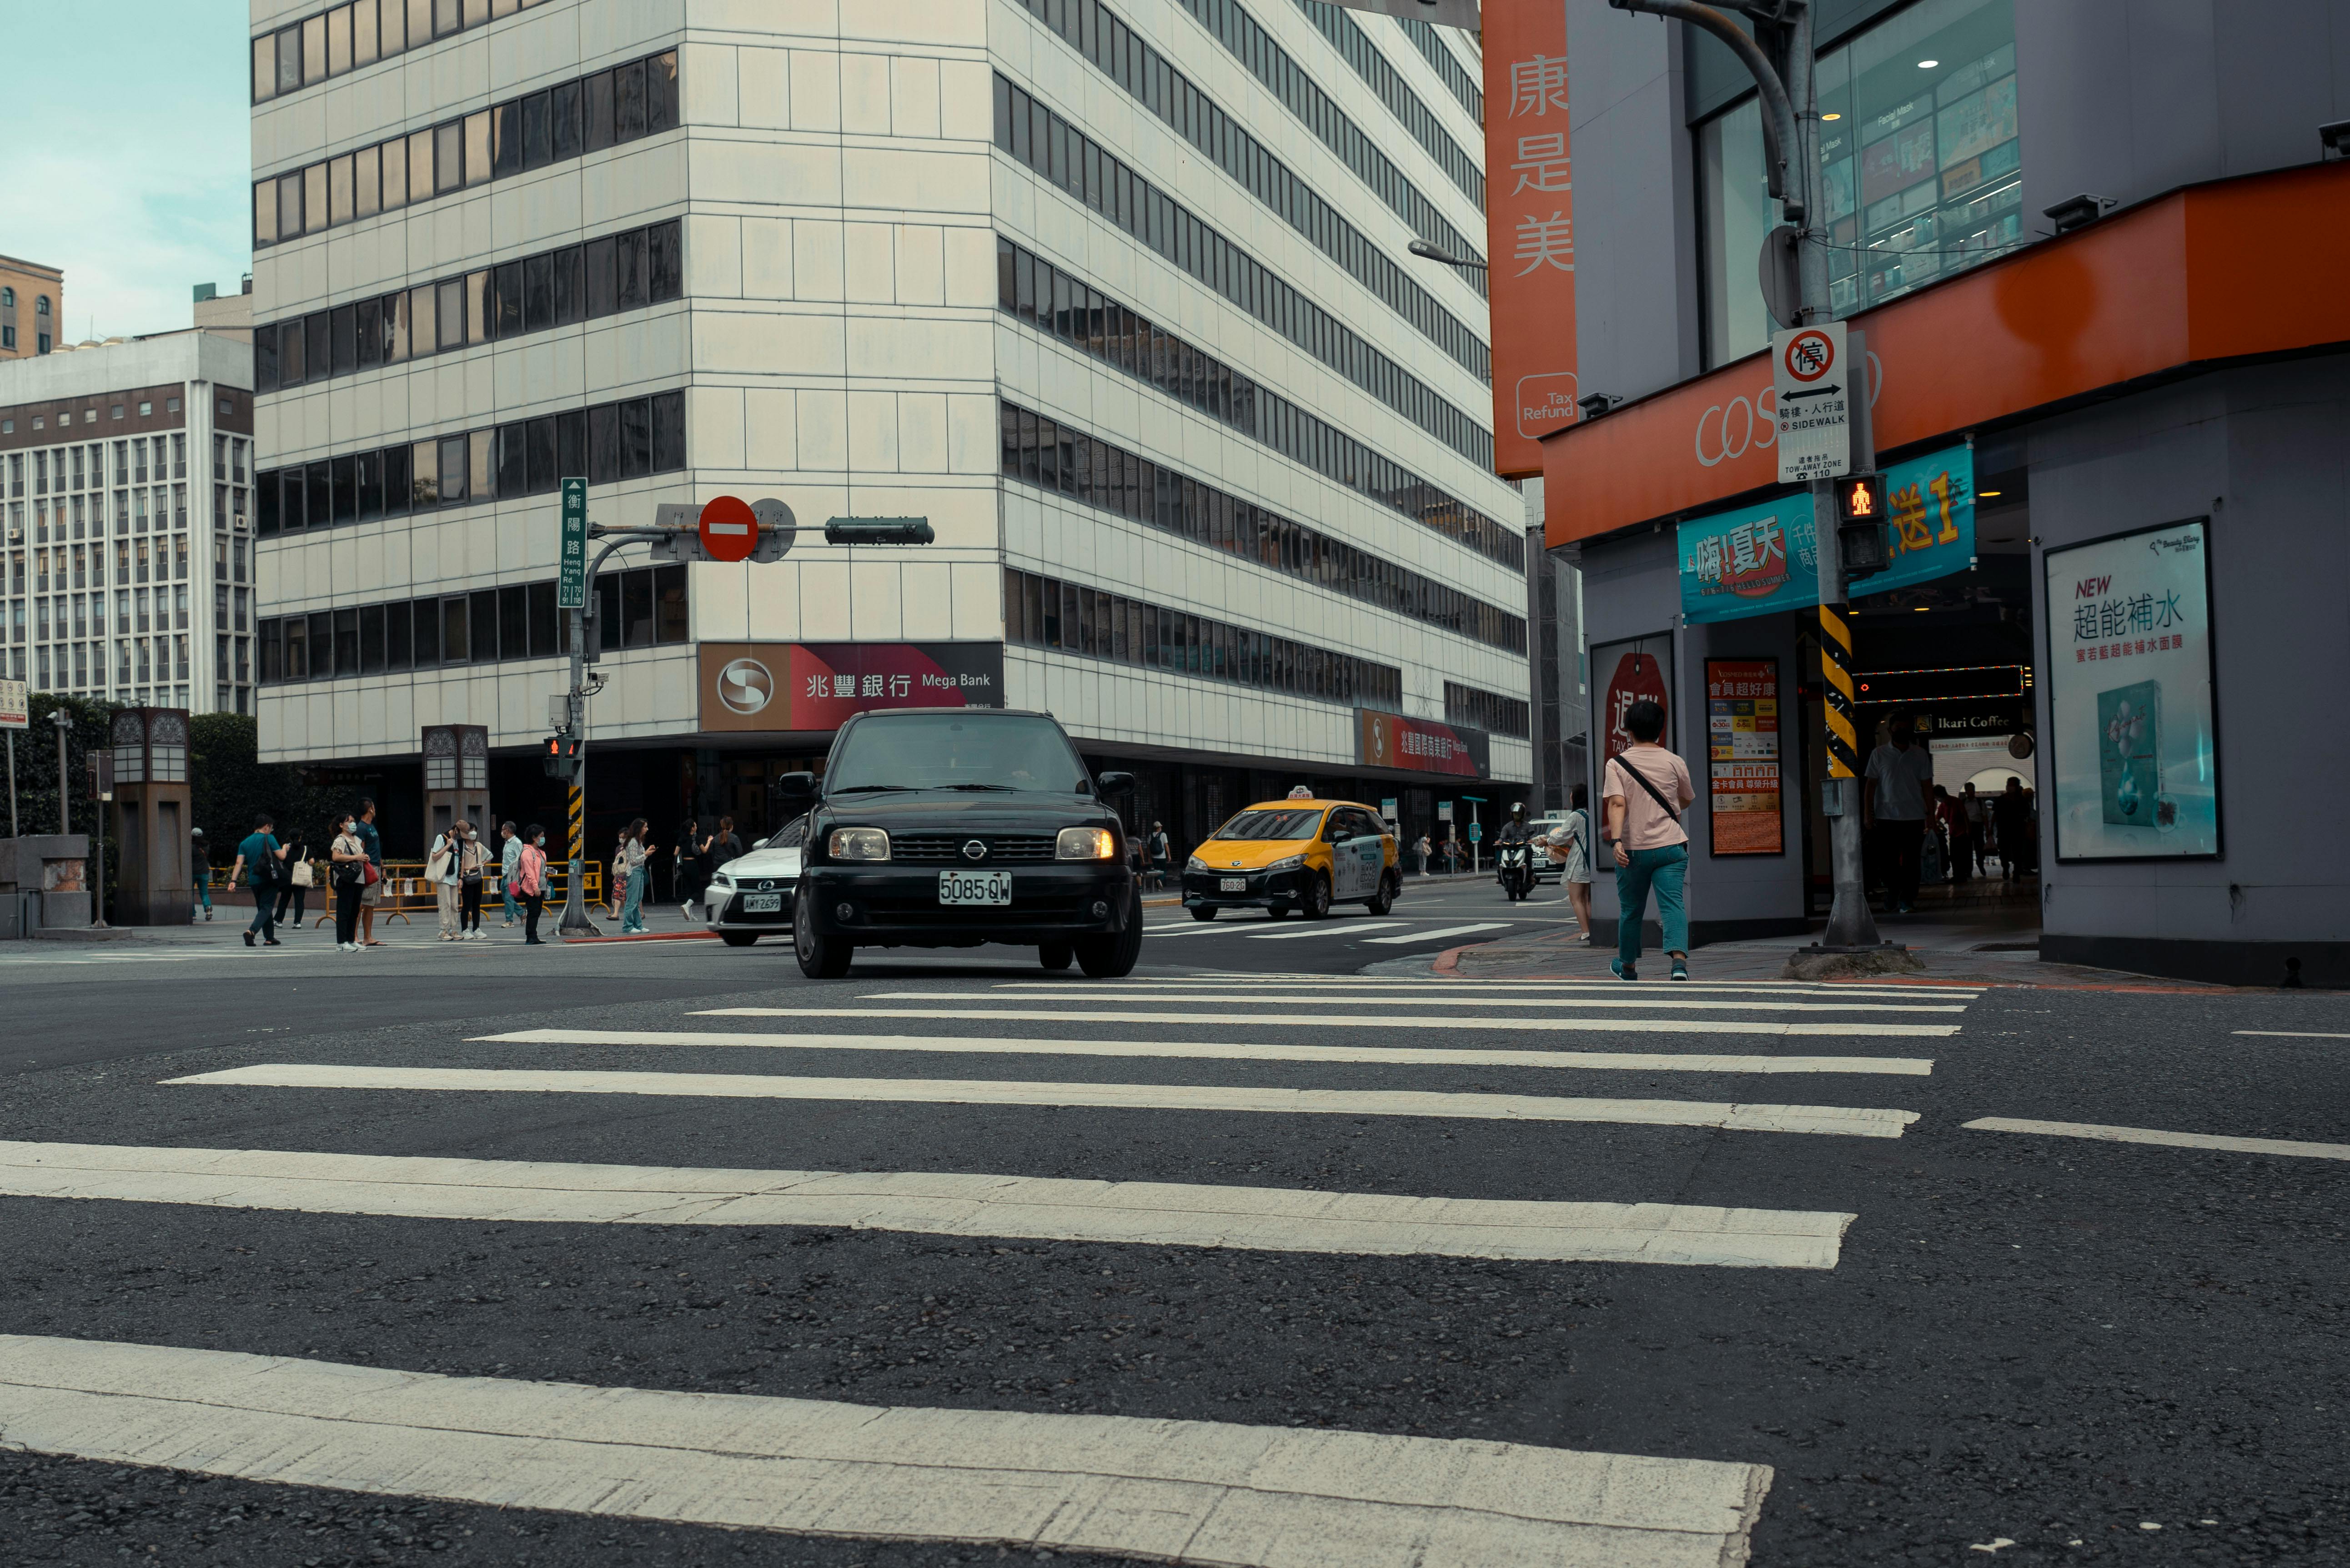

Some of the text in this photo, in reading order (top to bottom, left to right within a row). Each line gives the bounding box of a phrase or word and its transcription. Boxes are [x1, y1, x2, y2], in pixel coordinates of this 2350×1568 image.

[1878, 109, 1896, 127] Facial
[1897, 101, 1914, 119] Mask
[1826, 136, 1842, 151] Mask
[1508, 55, 1575, 277] 康是美
[1795, 342, 1823, 372] 停
[1547, 392, 1572, 405] Tax
[1523, 402, 1573, 420] Refund
[1792, 415, 1845, 430] SIDEWALK
[1785, 459, 1842, 474] TOW-AWAY ZONE
[1798, 454, 1828, 464] 違者拖吊
[1813, 469, 1830, 478] 110
[1888, 471, 1958, 558] 送1
[567, 494, 581, 555] 衡陽路
[564, 559, 581, 567] Heng
[563, 568, 581, 576] Yang
[1736, 581, 1761, 590] HELLO
[1762, 573, 1791, 586] SUMMER
[2076, 575, 2111, 599] NEW
[2074, 589, 2183, 642] 超能補水
[806, 673, 990, 698] 兆豐銀行 Mega Bank
[1710, 682, 1776, 696] 會員超好康
[1938, 715, 2010, 729] Ikari Coffee
[1401, 731, 1452, 760] 兆豐國際商業銀行
[1453, 740, 1461, 754] Mega
[1712, 779, 1744, 789] 金卡會員
